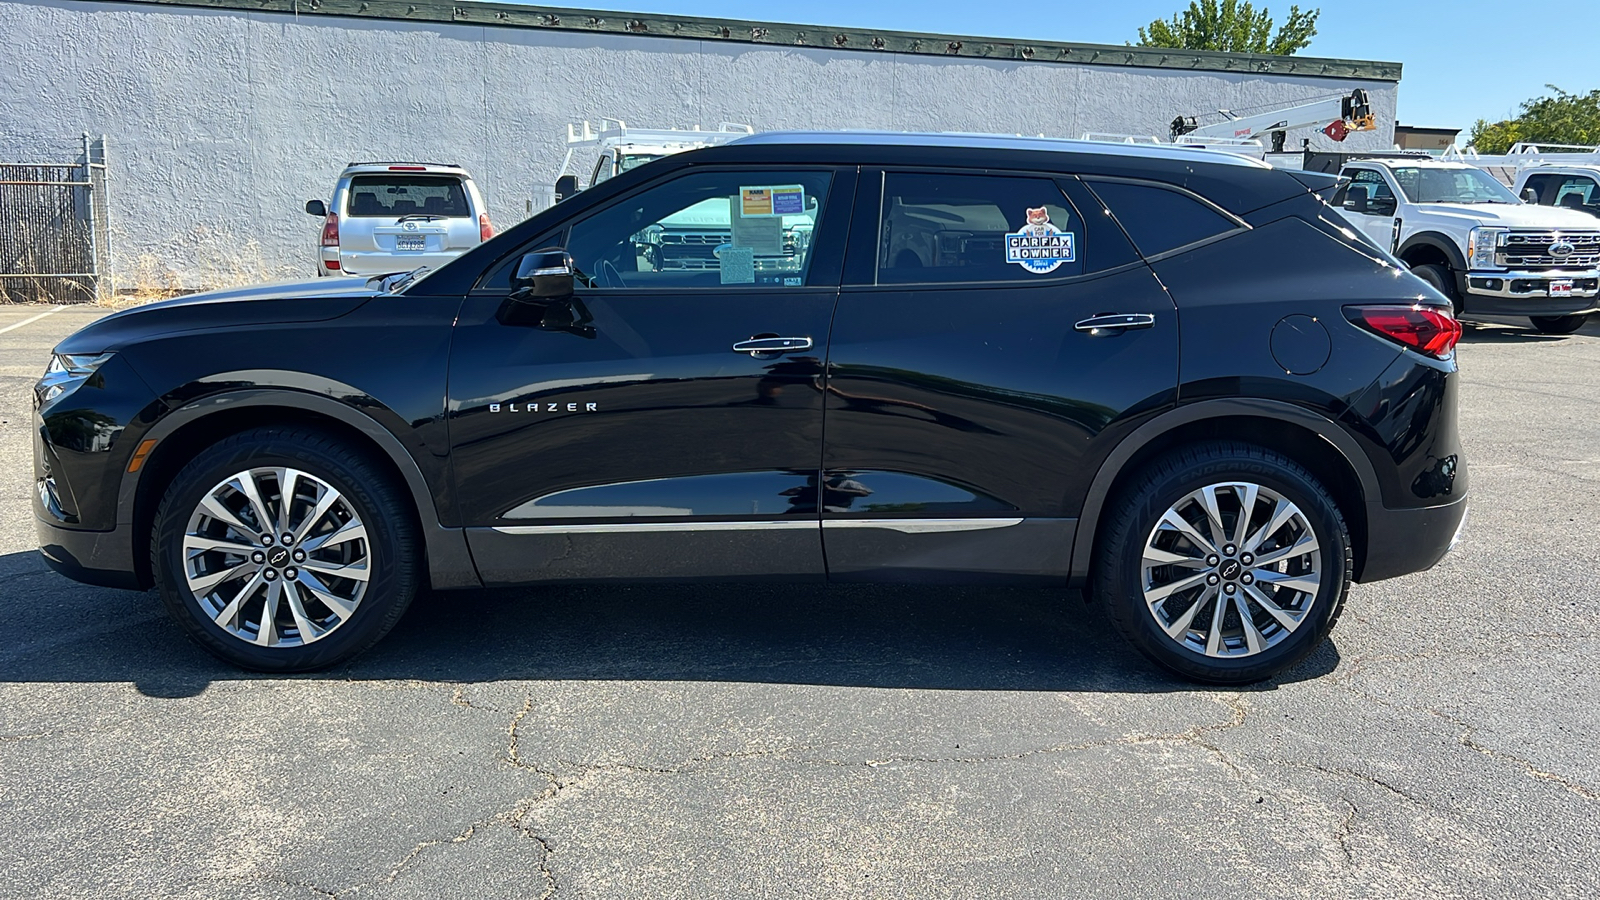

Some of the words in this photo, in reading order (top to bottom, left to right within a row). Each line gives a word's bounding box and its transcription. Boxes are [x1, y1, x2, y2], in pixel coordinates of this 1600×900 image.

[1010, 238, 1069, 247] CARFAX
[1021, 248, 1070, 258] OWNER
[489, 402, 597, 413] BLAZER
